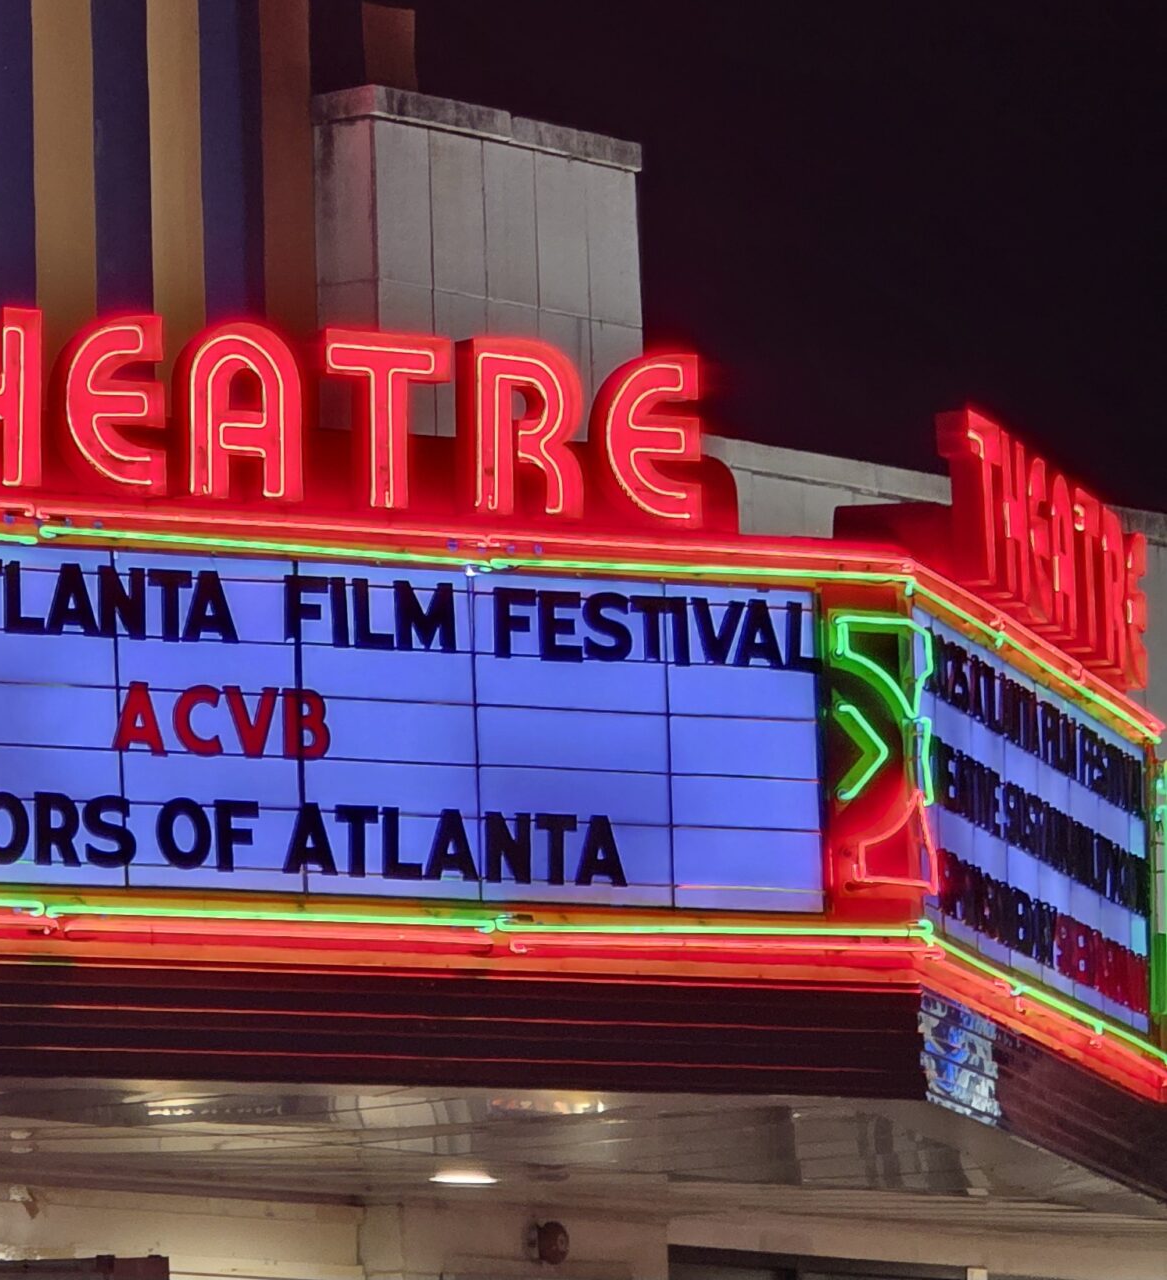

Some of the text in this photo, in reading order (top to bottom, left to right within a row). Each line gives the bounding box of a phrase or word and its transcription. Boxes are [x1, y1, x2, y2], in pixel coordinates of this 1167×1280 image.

[966, 409, 1147, 692] THEATRE
[284, 574, 457, 653] FILM
[493, 586, 823, 673] FESTIVAL
[112, 681, 332, 760] ACVB
[156, 797, 260, 873] OF
[282, 802, 628, 887] ATLANTA
